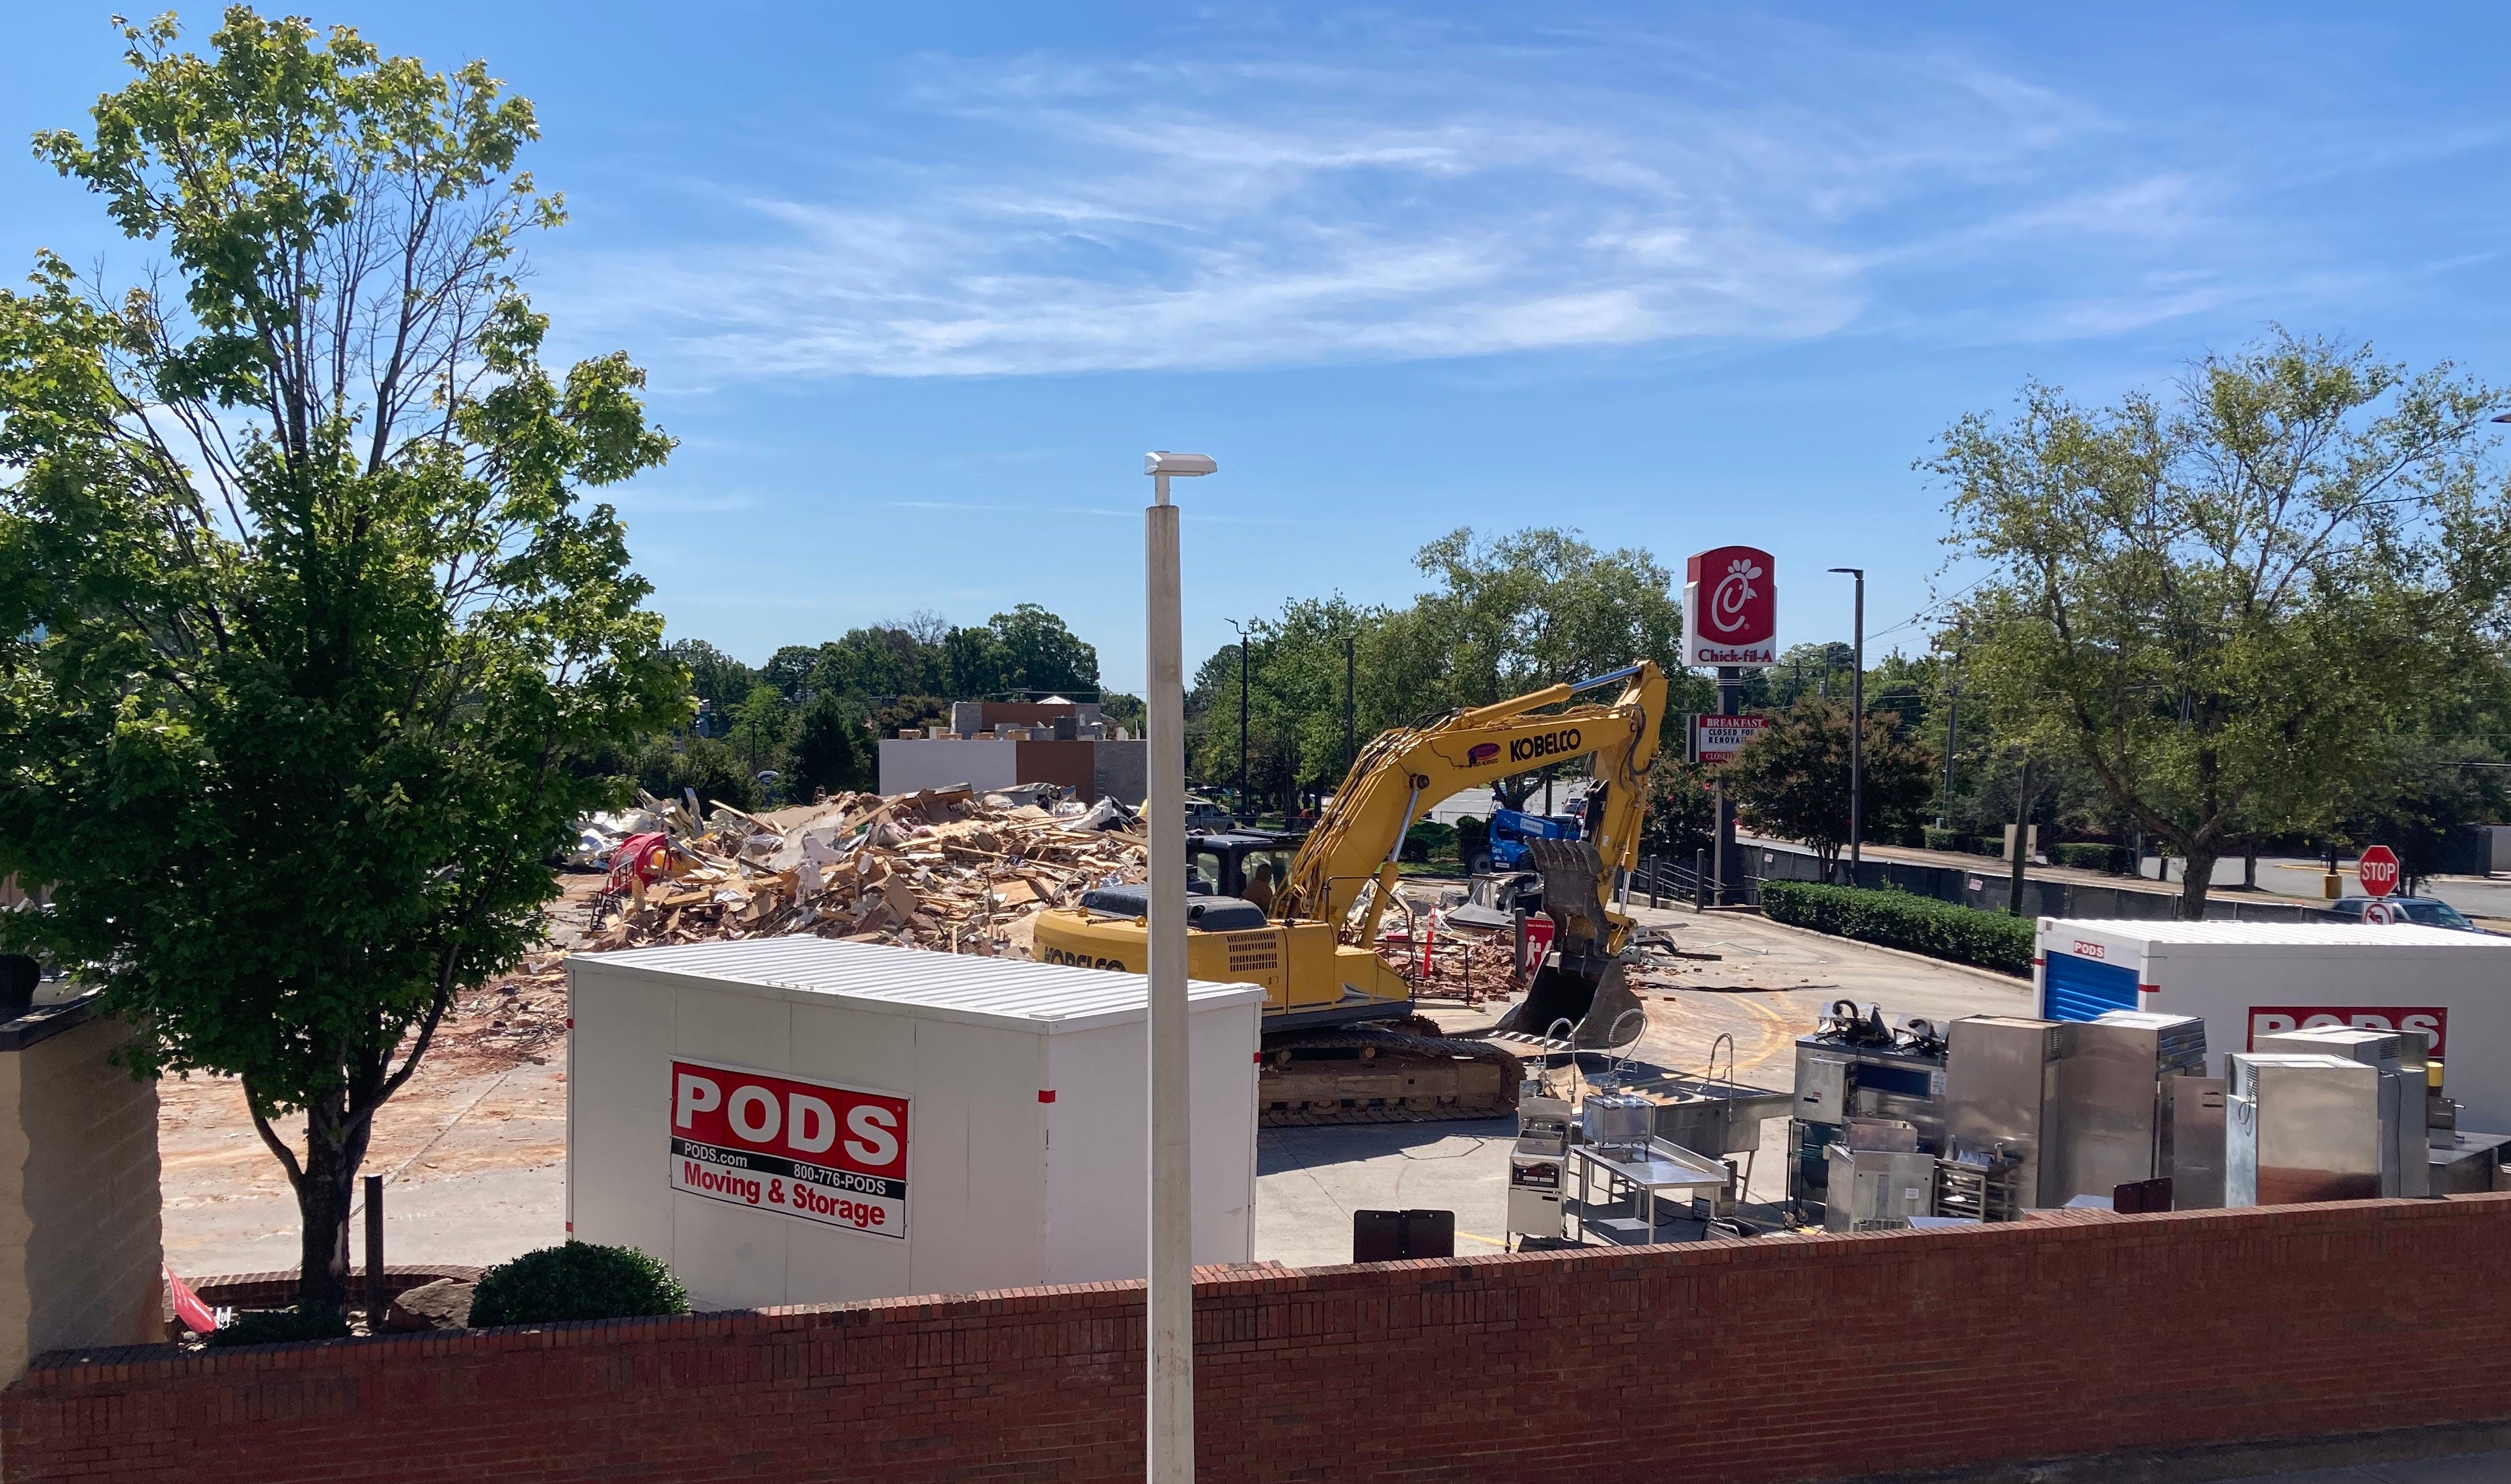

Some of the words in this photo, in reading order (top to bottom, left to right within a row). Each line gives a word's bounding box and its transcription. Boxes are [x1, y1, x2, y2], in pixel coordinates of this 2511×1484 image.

[1698, 649, 1773, 663] Chick-fil-A
[1706, 717, 1764, 728] BREAKFAST
[1510, 728, 1581, 763] KOBELCO
[2362, 861, 2396, 881] STOP
[2075, 942, 2103, 957] PODS
[676, 1073, 898, 1166] PODS
[684, 1142, 748, 1168] PODS.com
[794, 1164, 886, 1195] 800-776-PODS
[684, 1161, 760, 1204] Moving
[768, 1178, 786, 1204] &
[792, 1183, 885, 1228] Storage
